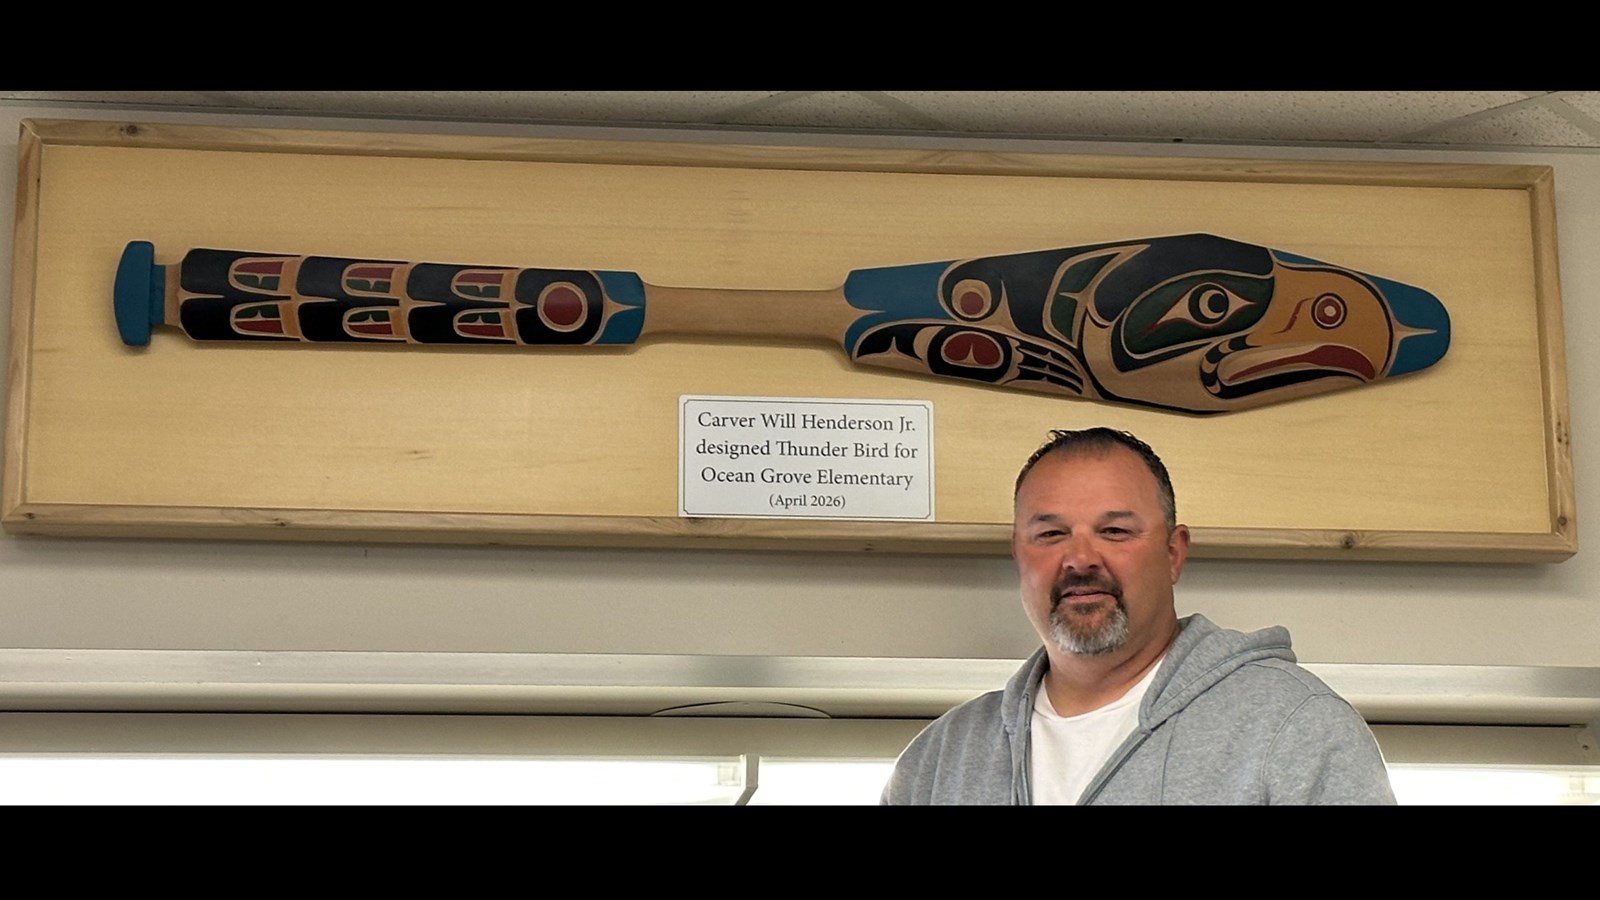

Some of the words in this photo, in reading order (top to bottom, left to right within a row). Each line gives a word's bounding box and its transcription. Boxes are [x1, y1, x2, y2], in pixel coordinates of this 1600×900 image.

[697, 411, 756, 428] Carver
[760, 413, 796, 429] Will
[802, 414, 893, 431] Henderson
[899, 416, 916, 433] Jr.
[696, 438, 771, 459] designed
[775, 440, 848, 457] Thunder
[854, 442, 889, 458] Bird
[894, 442, 918, 458] for
[701, 466, 755, 483] Ocean
[760, 468, 812, 484] Grove
[817, 469, 914, 490] Elementary
[769, 494, 807, 509] (April
[810, 495, 846, 508] 2026)
